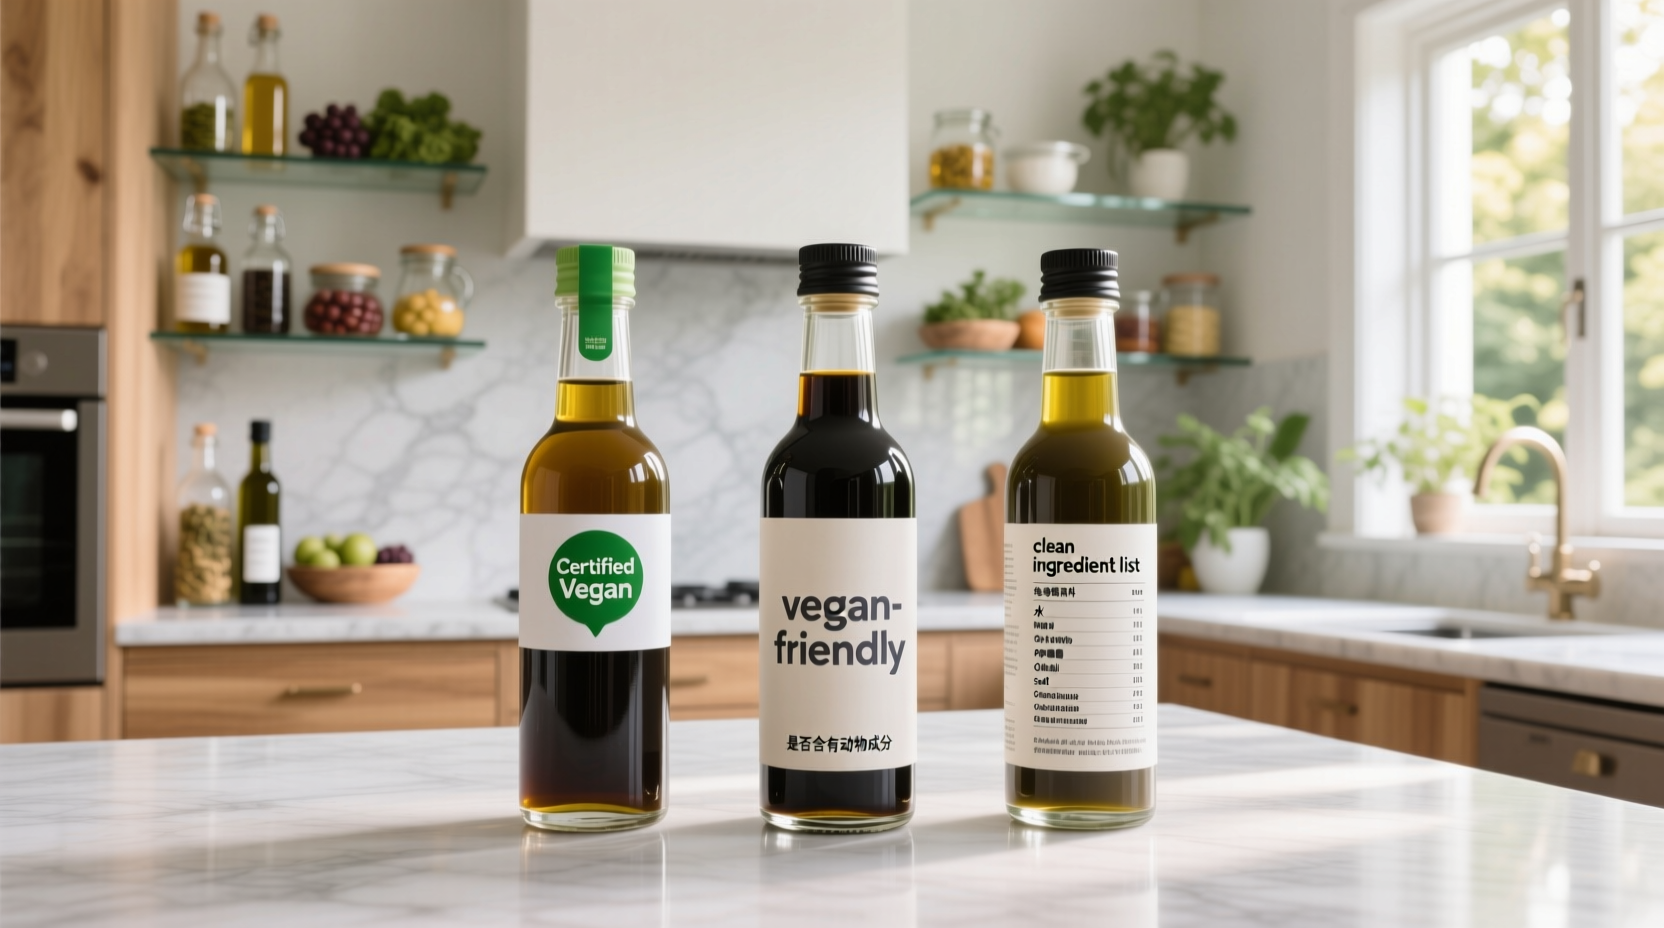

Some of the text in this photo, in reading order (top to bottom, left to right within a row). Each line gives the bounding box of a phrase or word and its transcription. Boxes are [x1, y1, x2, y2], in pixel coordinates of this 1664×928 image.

[1033, 537, 1075, 554] clean
[556, 557, 635, 575] Certified
[1033, 555, 1141, 577] ingredient list
[559, 578, 633, 606] Vegan
[781, 595, 902, 632] vegan-
[774, 629, 906, 676] friendly
